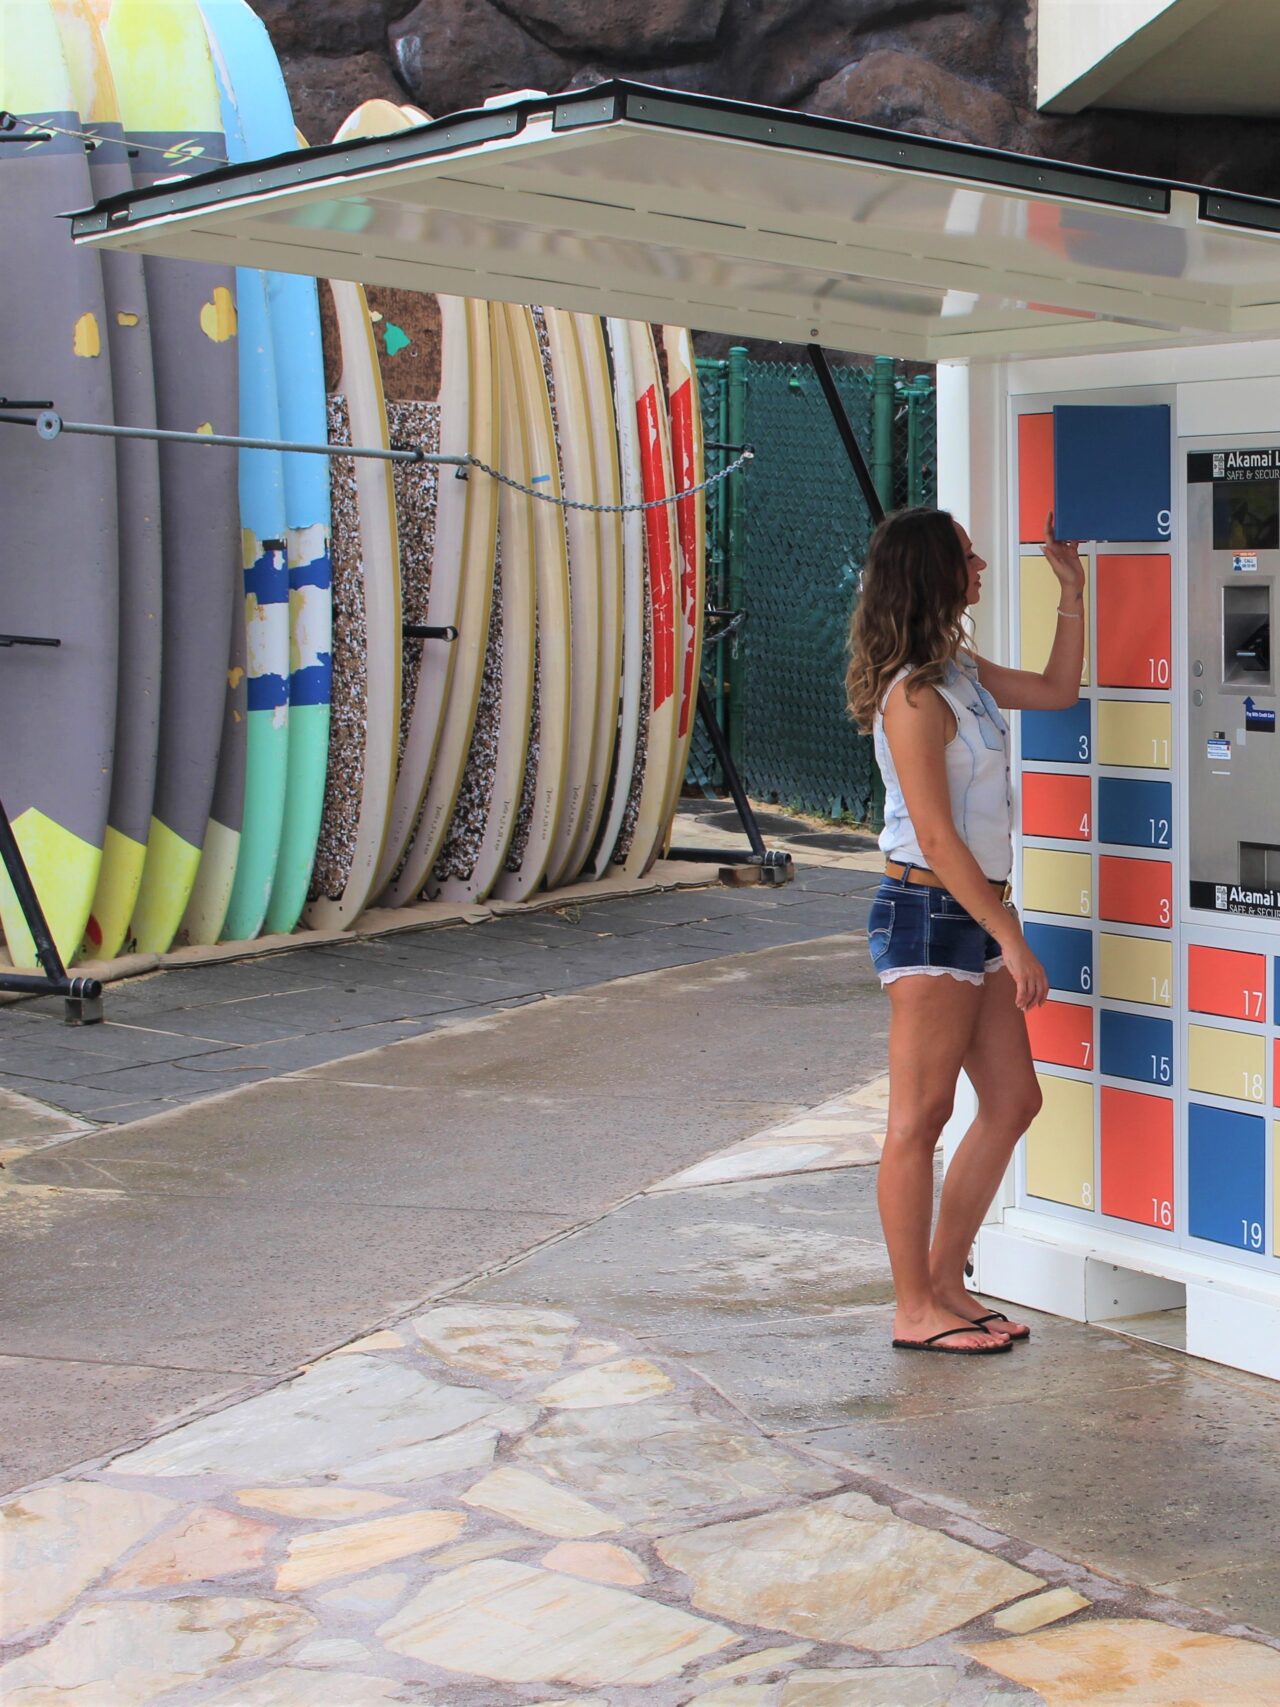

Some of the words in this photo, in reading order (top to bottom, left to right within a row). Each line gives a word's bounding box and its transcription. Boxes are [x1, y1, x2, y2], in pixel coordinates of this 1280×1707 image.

[1226, 450, 1272, 468] Akamai
[1226, 470, 1244, 480] SAFE
[1246, 470, 1253, 479] &
[1157, 510, 1171, 535] 9
[1149, 658, 1169, 684] 10
[1078, 735, 1089, 760] 3
[1151, 739, 1168, 765] 11
[1079, 813, 1089, 837] 4
[1149, 819, 1168, 844] 12
[1080, 890, 1089, 914] 5
[1229, 886, 1274, 906] Akamai
[1159, 898, 1170, 924] 3
[1229, 905, 1246, 915] SAFE
[1249, 906, 1256, 916] &
[1080, 966, 1091, 990] 6
[1151, 976, 1171, 1003] 14
[1243, 990, 1263, 1017] 17
[1081, 1042, 1091, 1066] 7
[1151, 1055, 1170, 1082] 15
[1243, 1072, 1263, 1100] 18
[1081, 1182, 1092, 1206] 8
[1151, 1198, 1171, 1226] 16
[1241, 1220, 1262, 1248] 19
